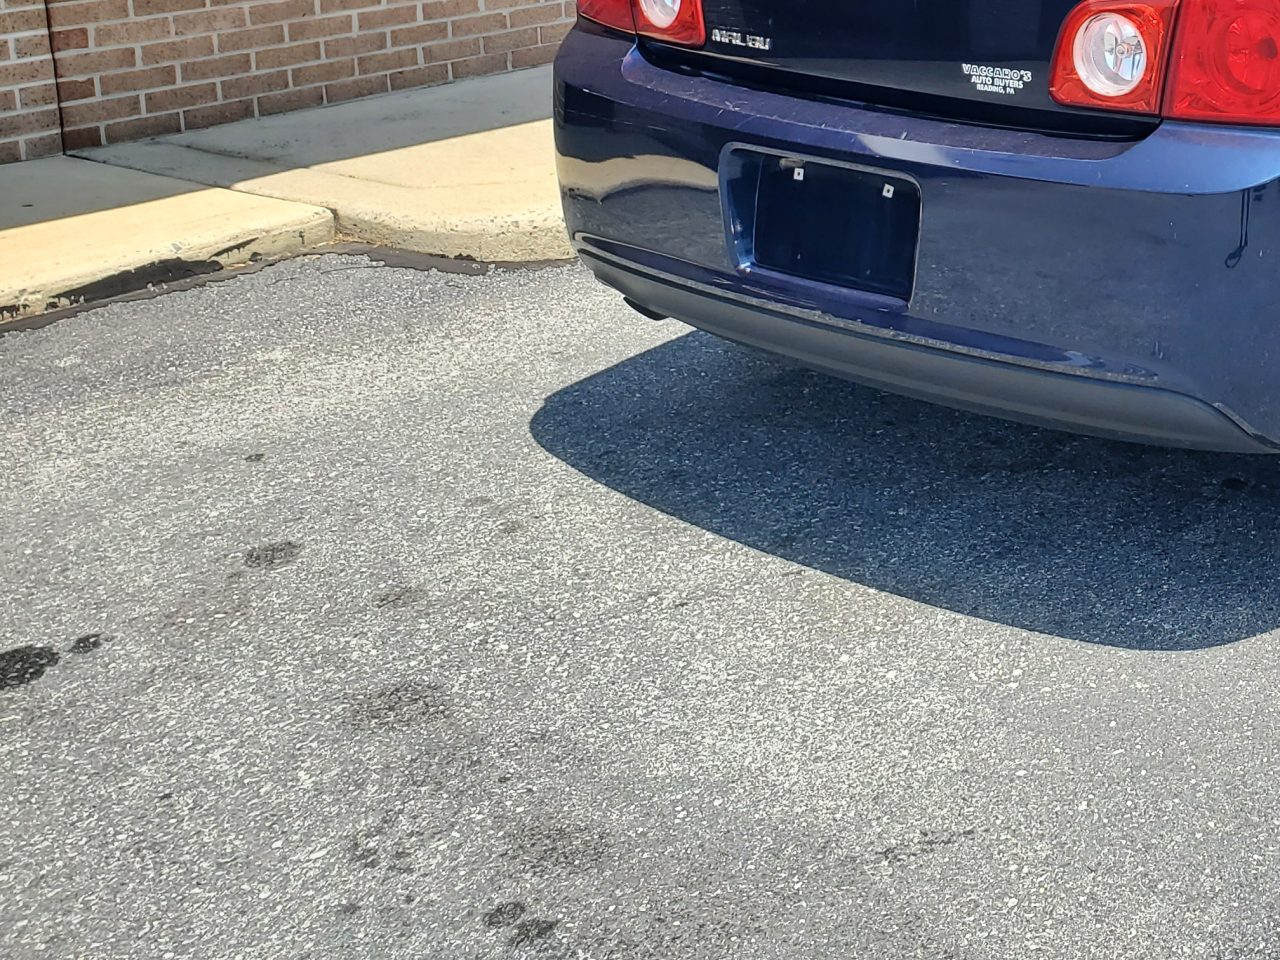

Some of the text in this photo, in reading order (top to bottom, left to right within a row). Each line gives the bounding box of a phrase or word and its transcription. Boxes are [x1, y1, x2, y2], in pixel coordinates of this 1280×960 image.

[962, 63, 1032, 82] VACCARO'S
[971, 75, 1024, 89] AUTO BUYERS
[976, 83, 1015, 95] READING, PA
